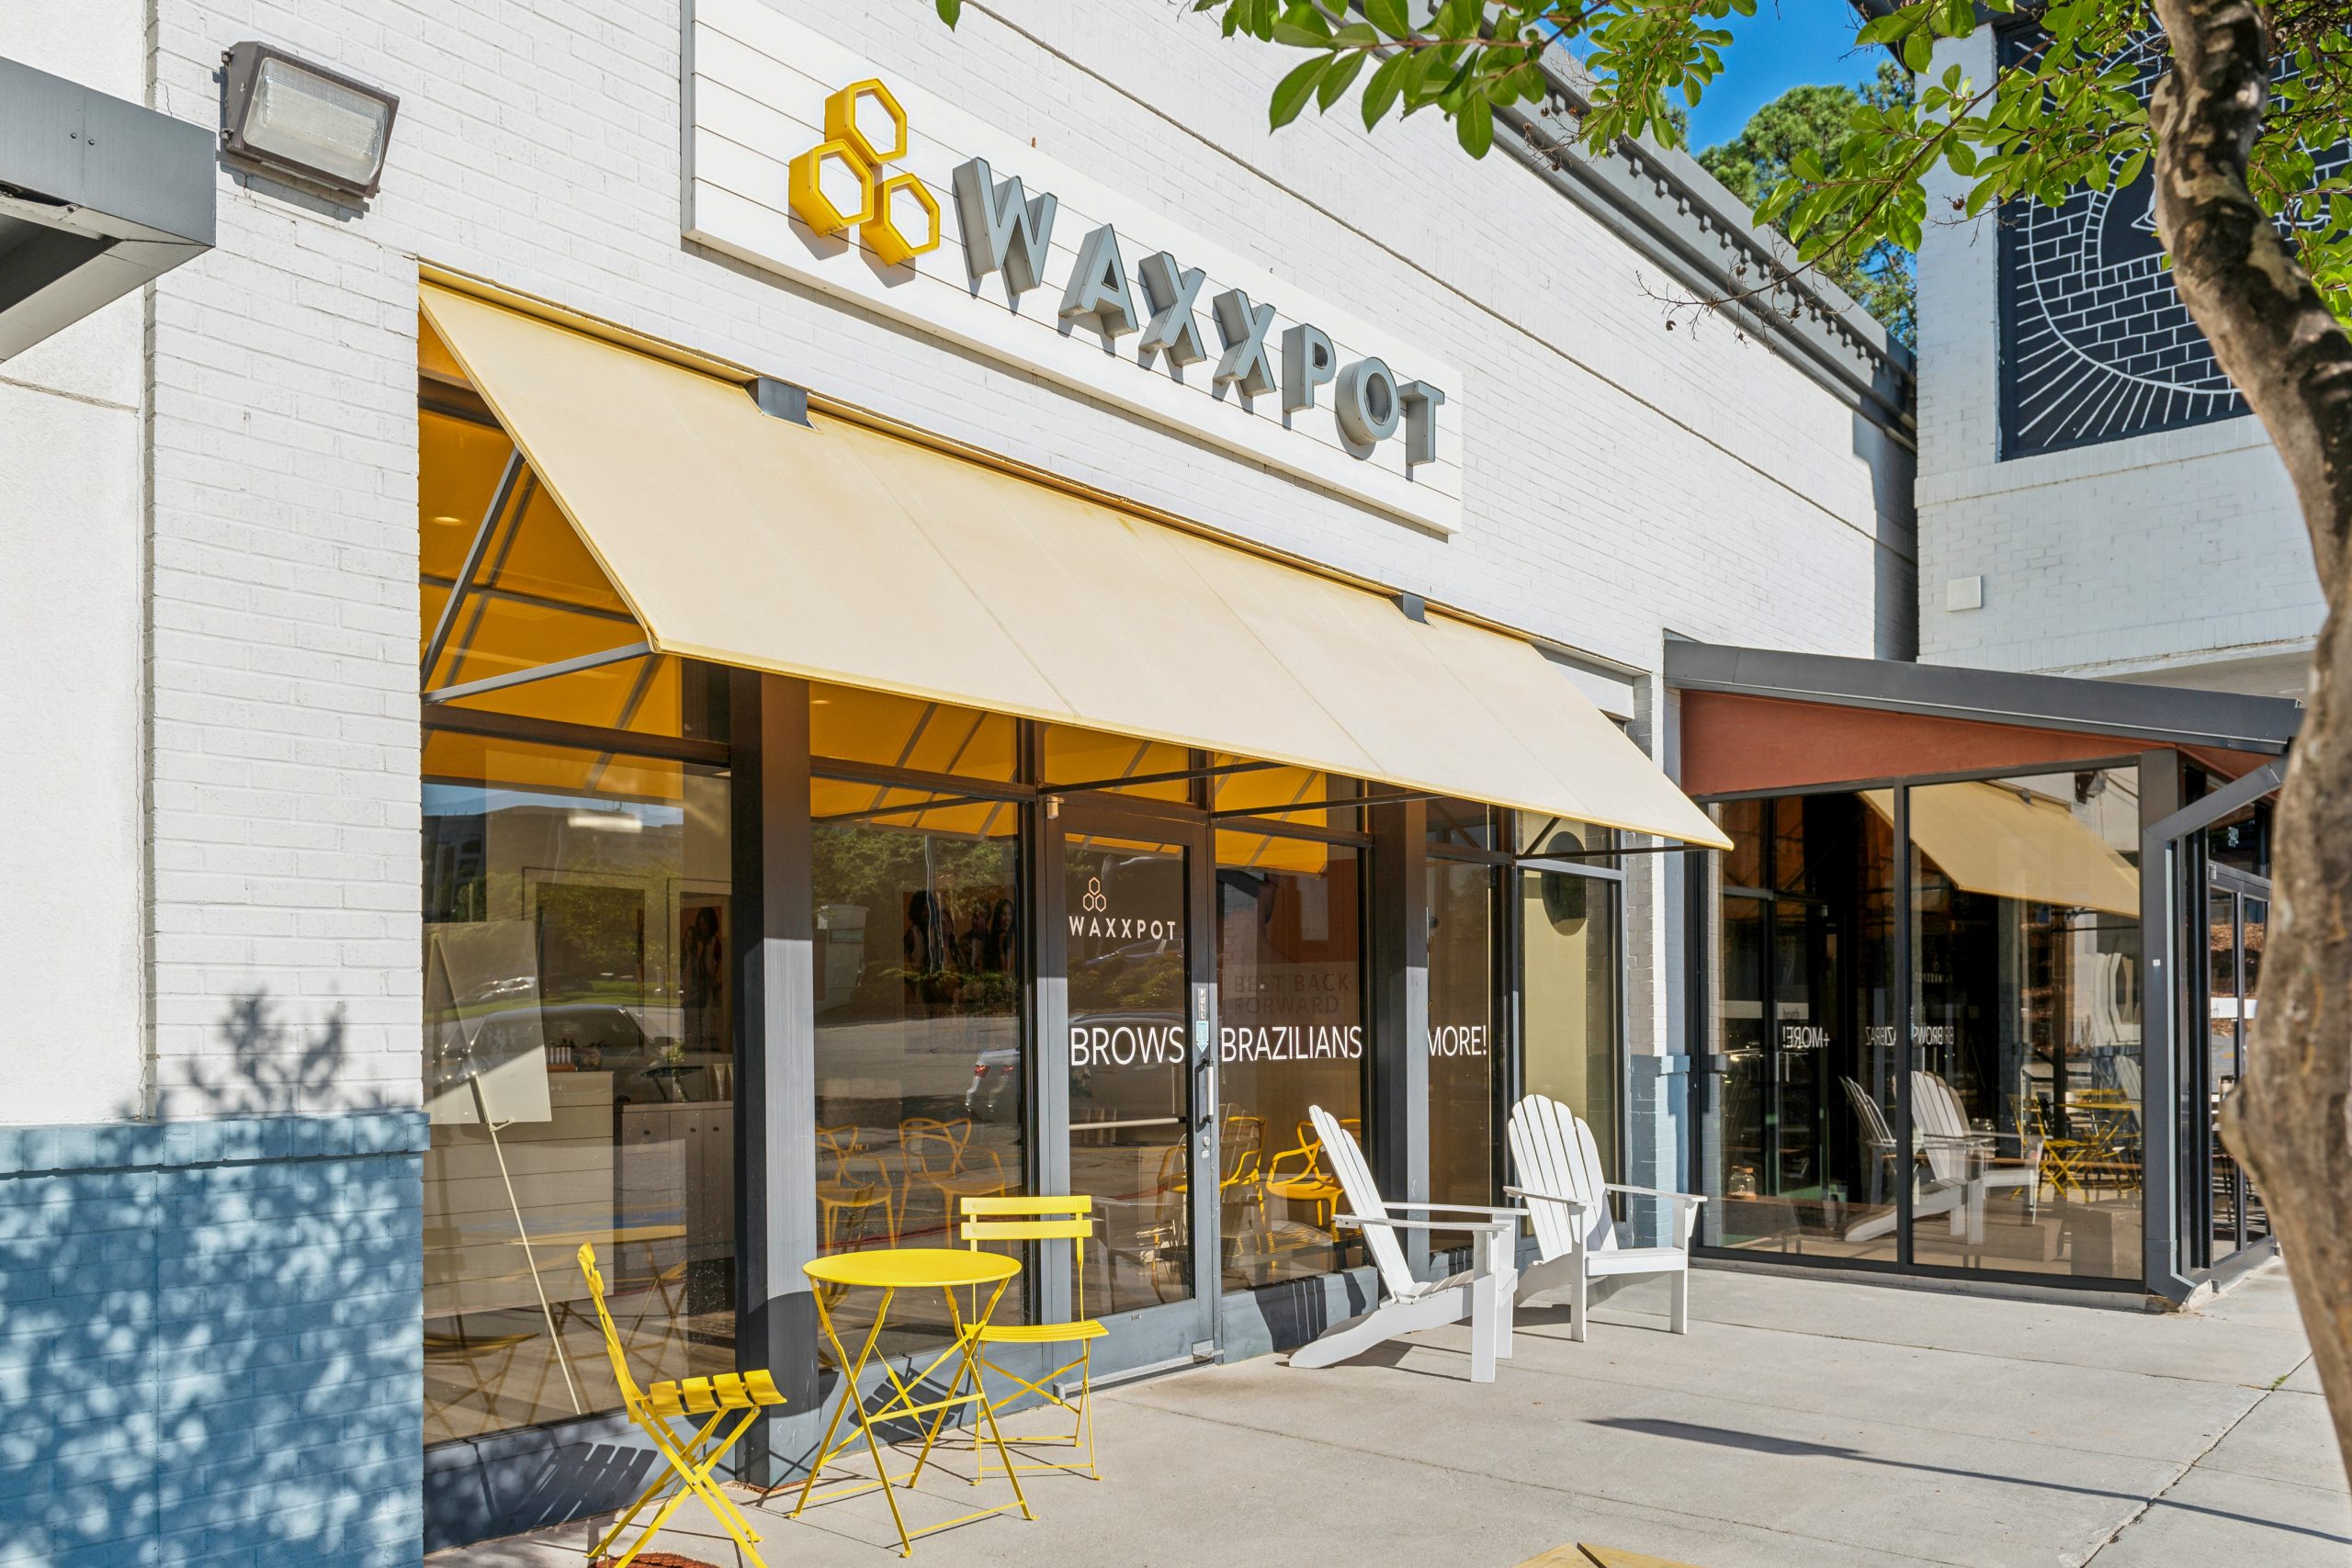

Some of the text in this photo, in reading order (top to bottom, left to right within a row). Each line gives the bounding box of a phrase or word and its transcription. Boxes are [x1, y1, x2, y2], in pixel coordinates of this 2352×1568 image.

[953, 156, 1446, 467] WAXXPOT
[1069, 916, 1176, 941] WAXXPOT
[1295, 972, 1350, 992] BACK
[1070, 1026, 1185, 1066] BROWS
[1220, 1025, 1363, 1063] BRAZILIANS
[1427, 1024, 1487, 1056] MORE!
